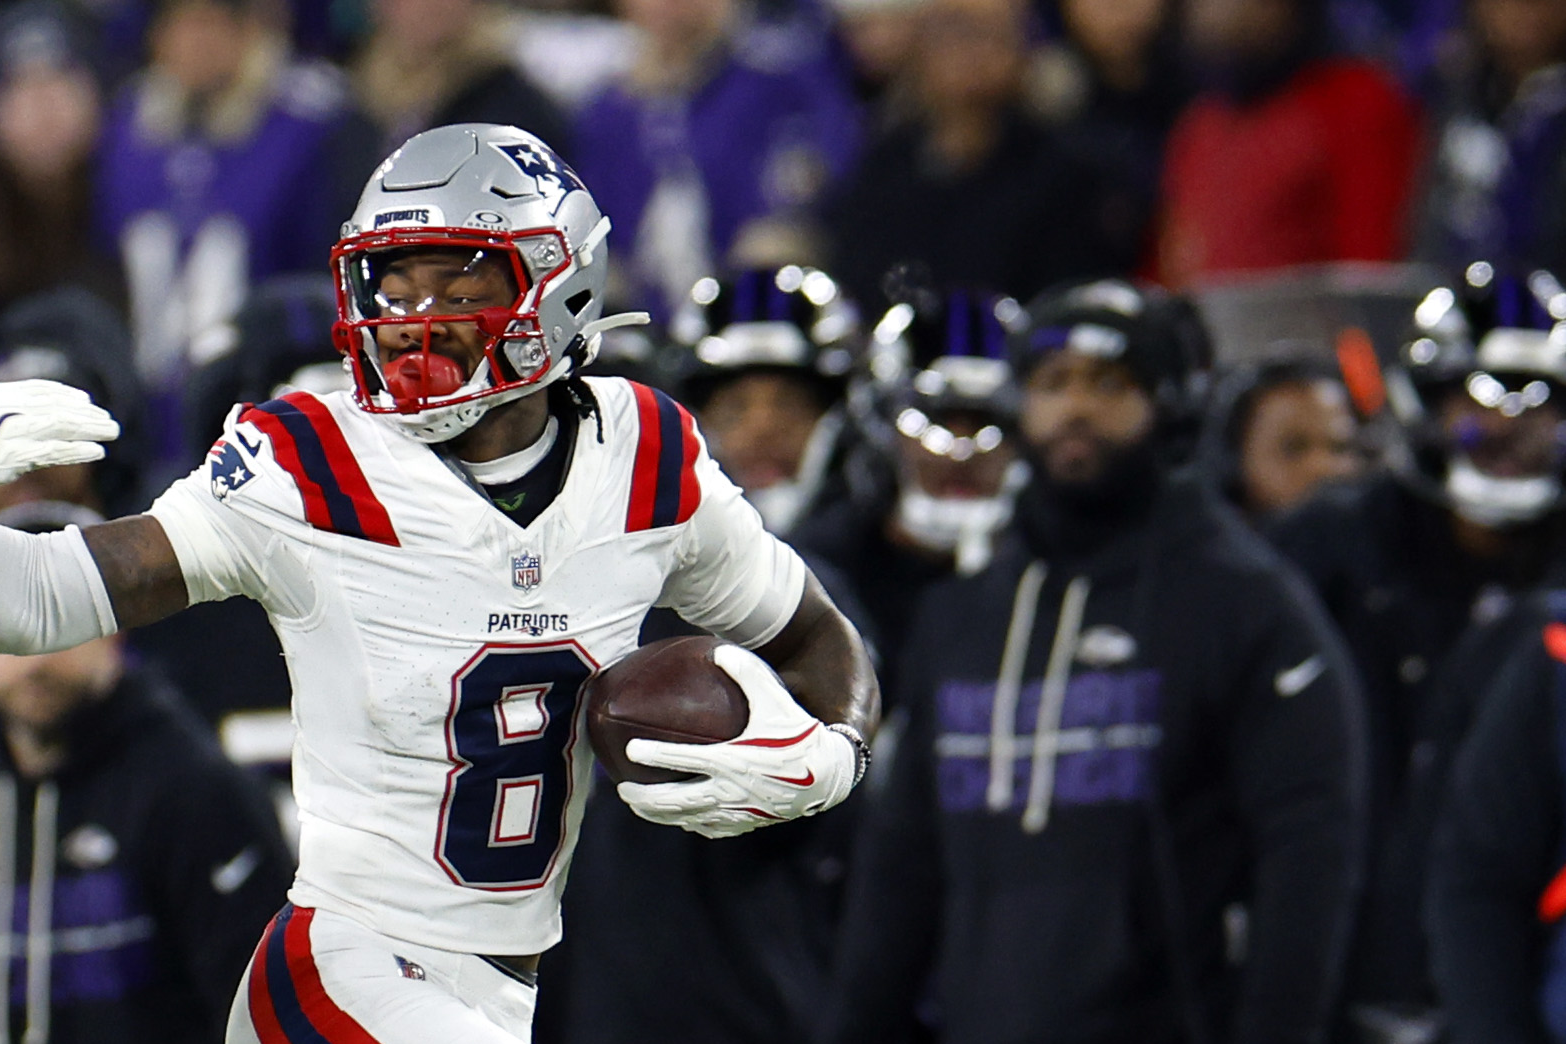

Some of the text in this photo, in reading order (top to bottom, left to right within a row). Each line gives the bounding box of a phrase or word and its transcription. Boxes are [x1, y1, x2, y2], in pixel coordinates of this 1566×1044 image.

[374, 209, 430, 230] PATRIOTS
[517, 569, 539, 585] NFL
[487, 613, 569, 634] PATRIOTS
[433, 639, 601, 892] 8
